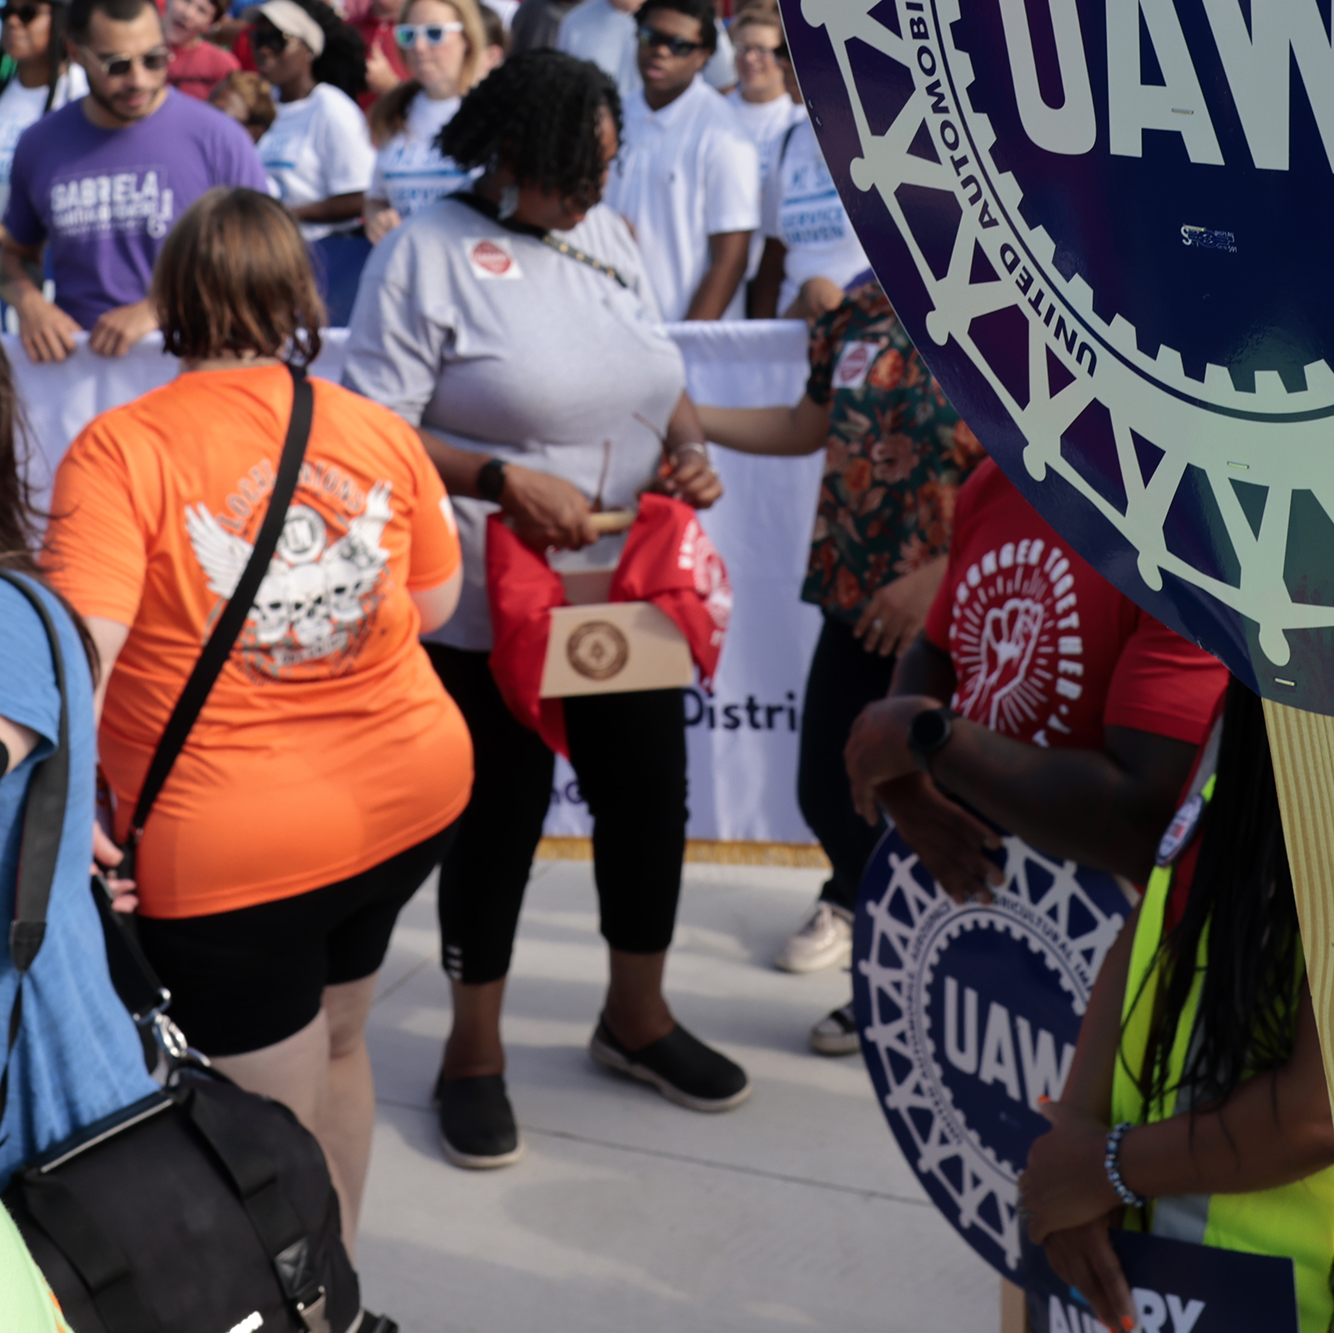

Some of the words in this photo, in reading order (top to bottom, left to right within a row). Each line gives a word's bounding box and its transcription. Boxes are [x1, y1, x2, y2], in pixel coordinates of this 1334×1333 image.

[999, 241, 1098, 378] UNITED
[296, 458, 367, 514] NIONS
[681, 688, 795, 730] Distri
[993, 893, 1074, 963] GRICULTURAL
[944, 974, 1077, 1114] UAW
